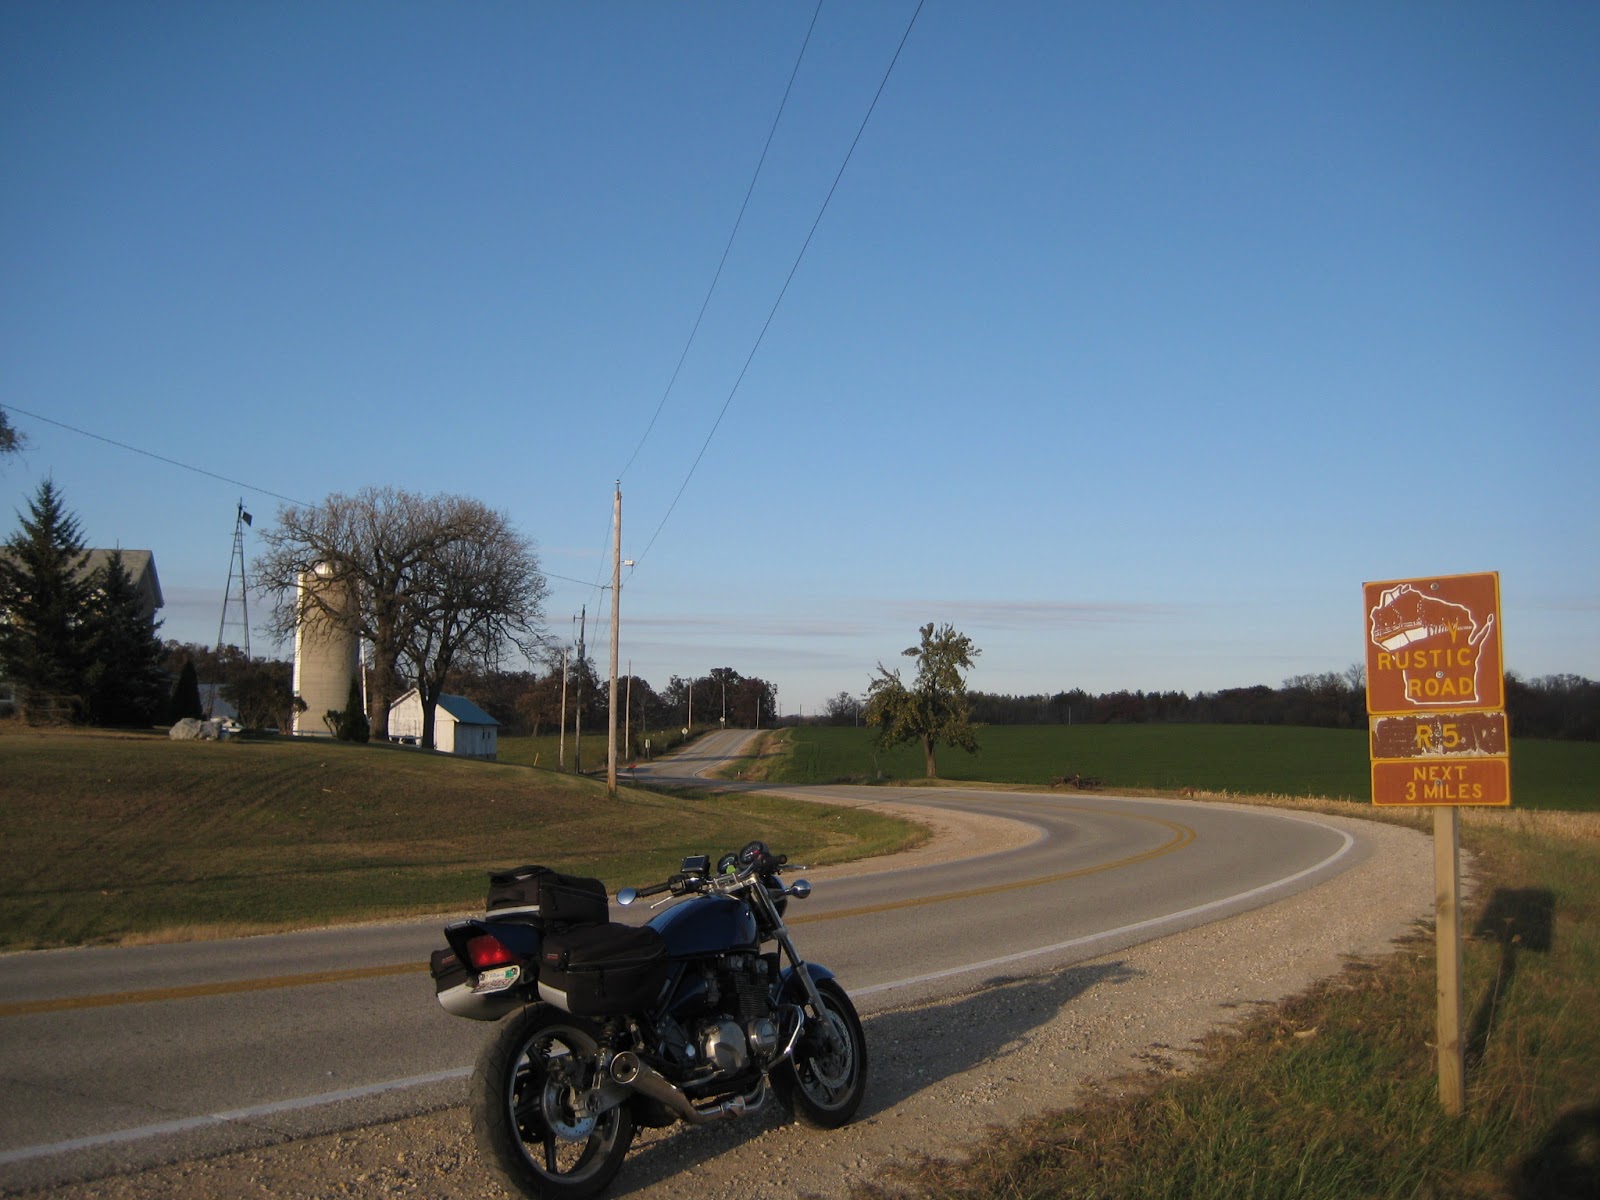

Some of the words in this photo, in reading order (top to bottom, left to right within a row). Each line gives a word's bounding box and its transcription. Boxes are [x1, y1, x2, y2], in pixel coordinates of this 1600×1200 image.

[1378, 648, 1471, 670] RUSTIC
[1409, 677, 1474, 697] ROAD
[1413, 766, 1467, 781] NEXT
[1406, 782, 1416, 801] 3
[1424, 784, 1482, 799] MILES
